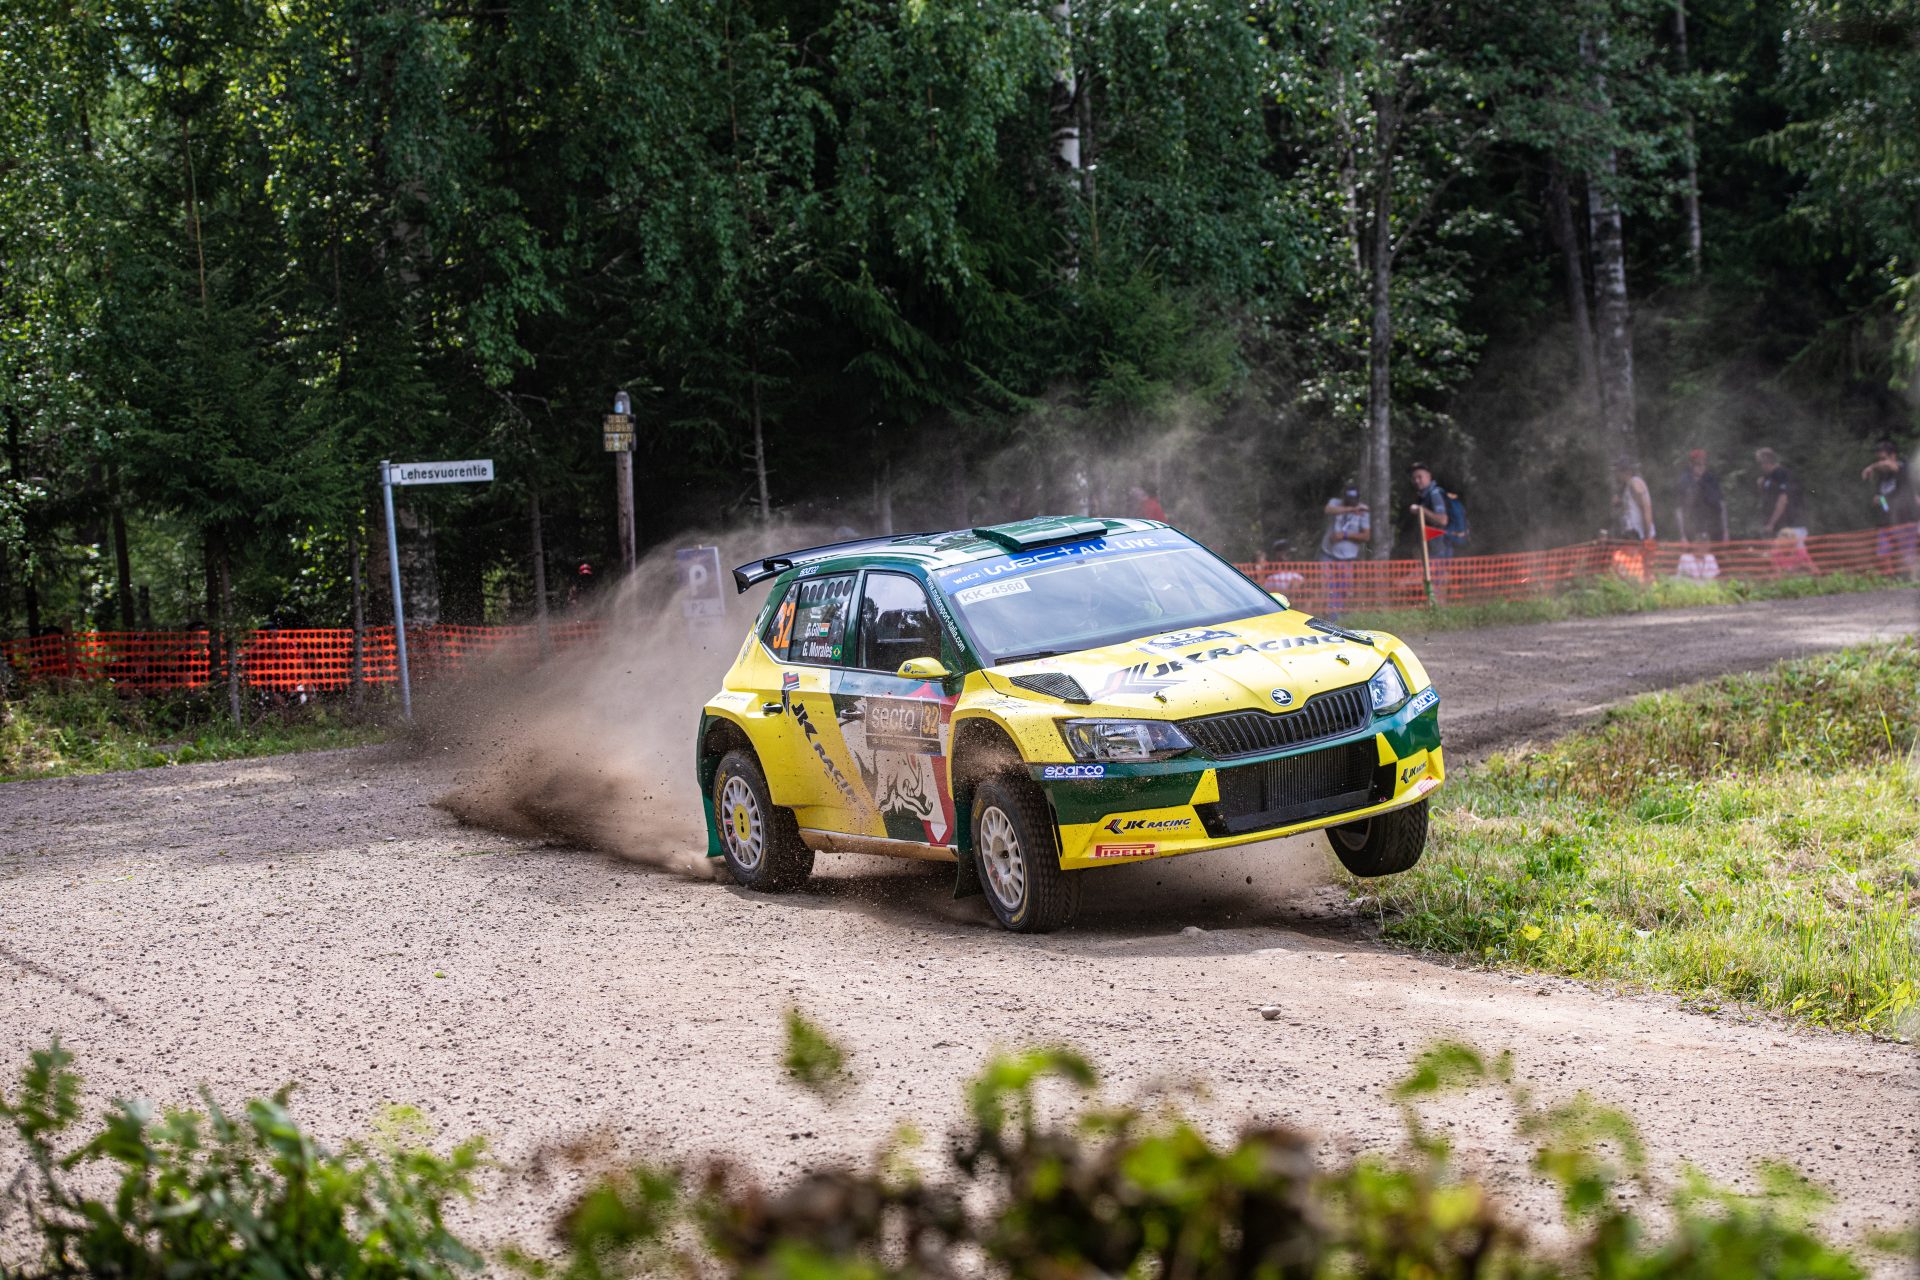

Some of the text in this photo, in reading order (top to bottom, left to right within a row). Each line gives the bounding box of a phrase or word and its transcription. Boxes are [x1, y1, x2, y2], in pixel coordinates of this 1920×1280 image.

[400, 464, 488, 480] Lehesvuorentie
[953, 572, 980, 585] WRC2
[1080, 543, 1116, 556] ALL
[1115, 538, 1159, 550] LIVE
[961, 581, 1025, 602] KK-4560
[926, 574, 967, 653] www.motorsport-italia.com
[773, 601, 796, 649] 32
[809, 641, 833, 658] Morales
[1207, 634, 1346, 661] RACING
[922, 705, 939, 734] 32
[1044, 765, 1104, 779] sparco
[1123, 818, 1192, 830] JK RACING
[1095, 843, 1156, 857] PIRELLI
